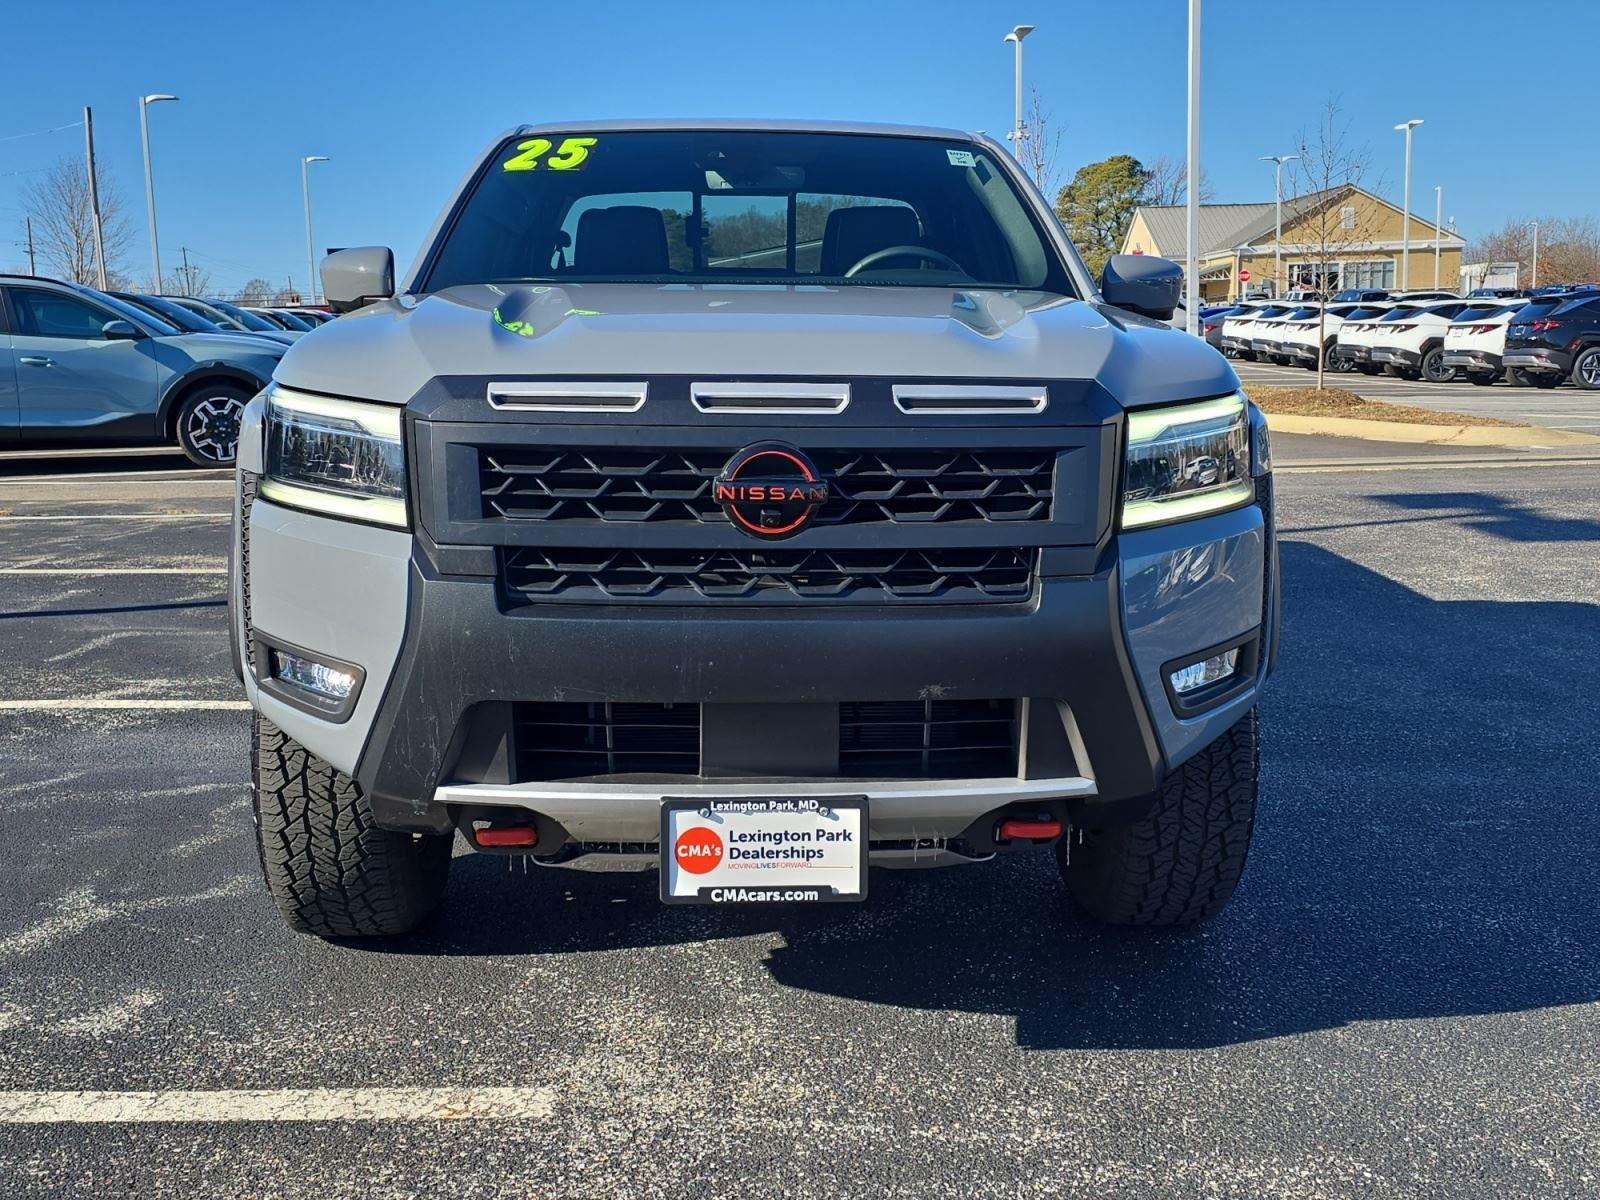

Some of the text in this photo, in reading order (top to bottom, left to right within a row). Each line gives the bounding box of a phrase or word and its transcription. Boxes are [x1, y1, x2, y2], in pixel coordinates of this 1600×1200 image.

[503, 138, 598, 170] 25
[718, 486, 825, 500] NISSAN
[710, 801, 767, 813] Lexington
[729, 829, 852, 844] Lexington Park
[677, 844, 722, 857] CMA's
[729, 846, 824, 861] Dealerships
[711, 888, 819, 902] CMAcars.com
